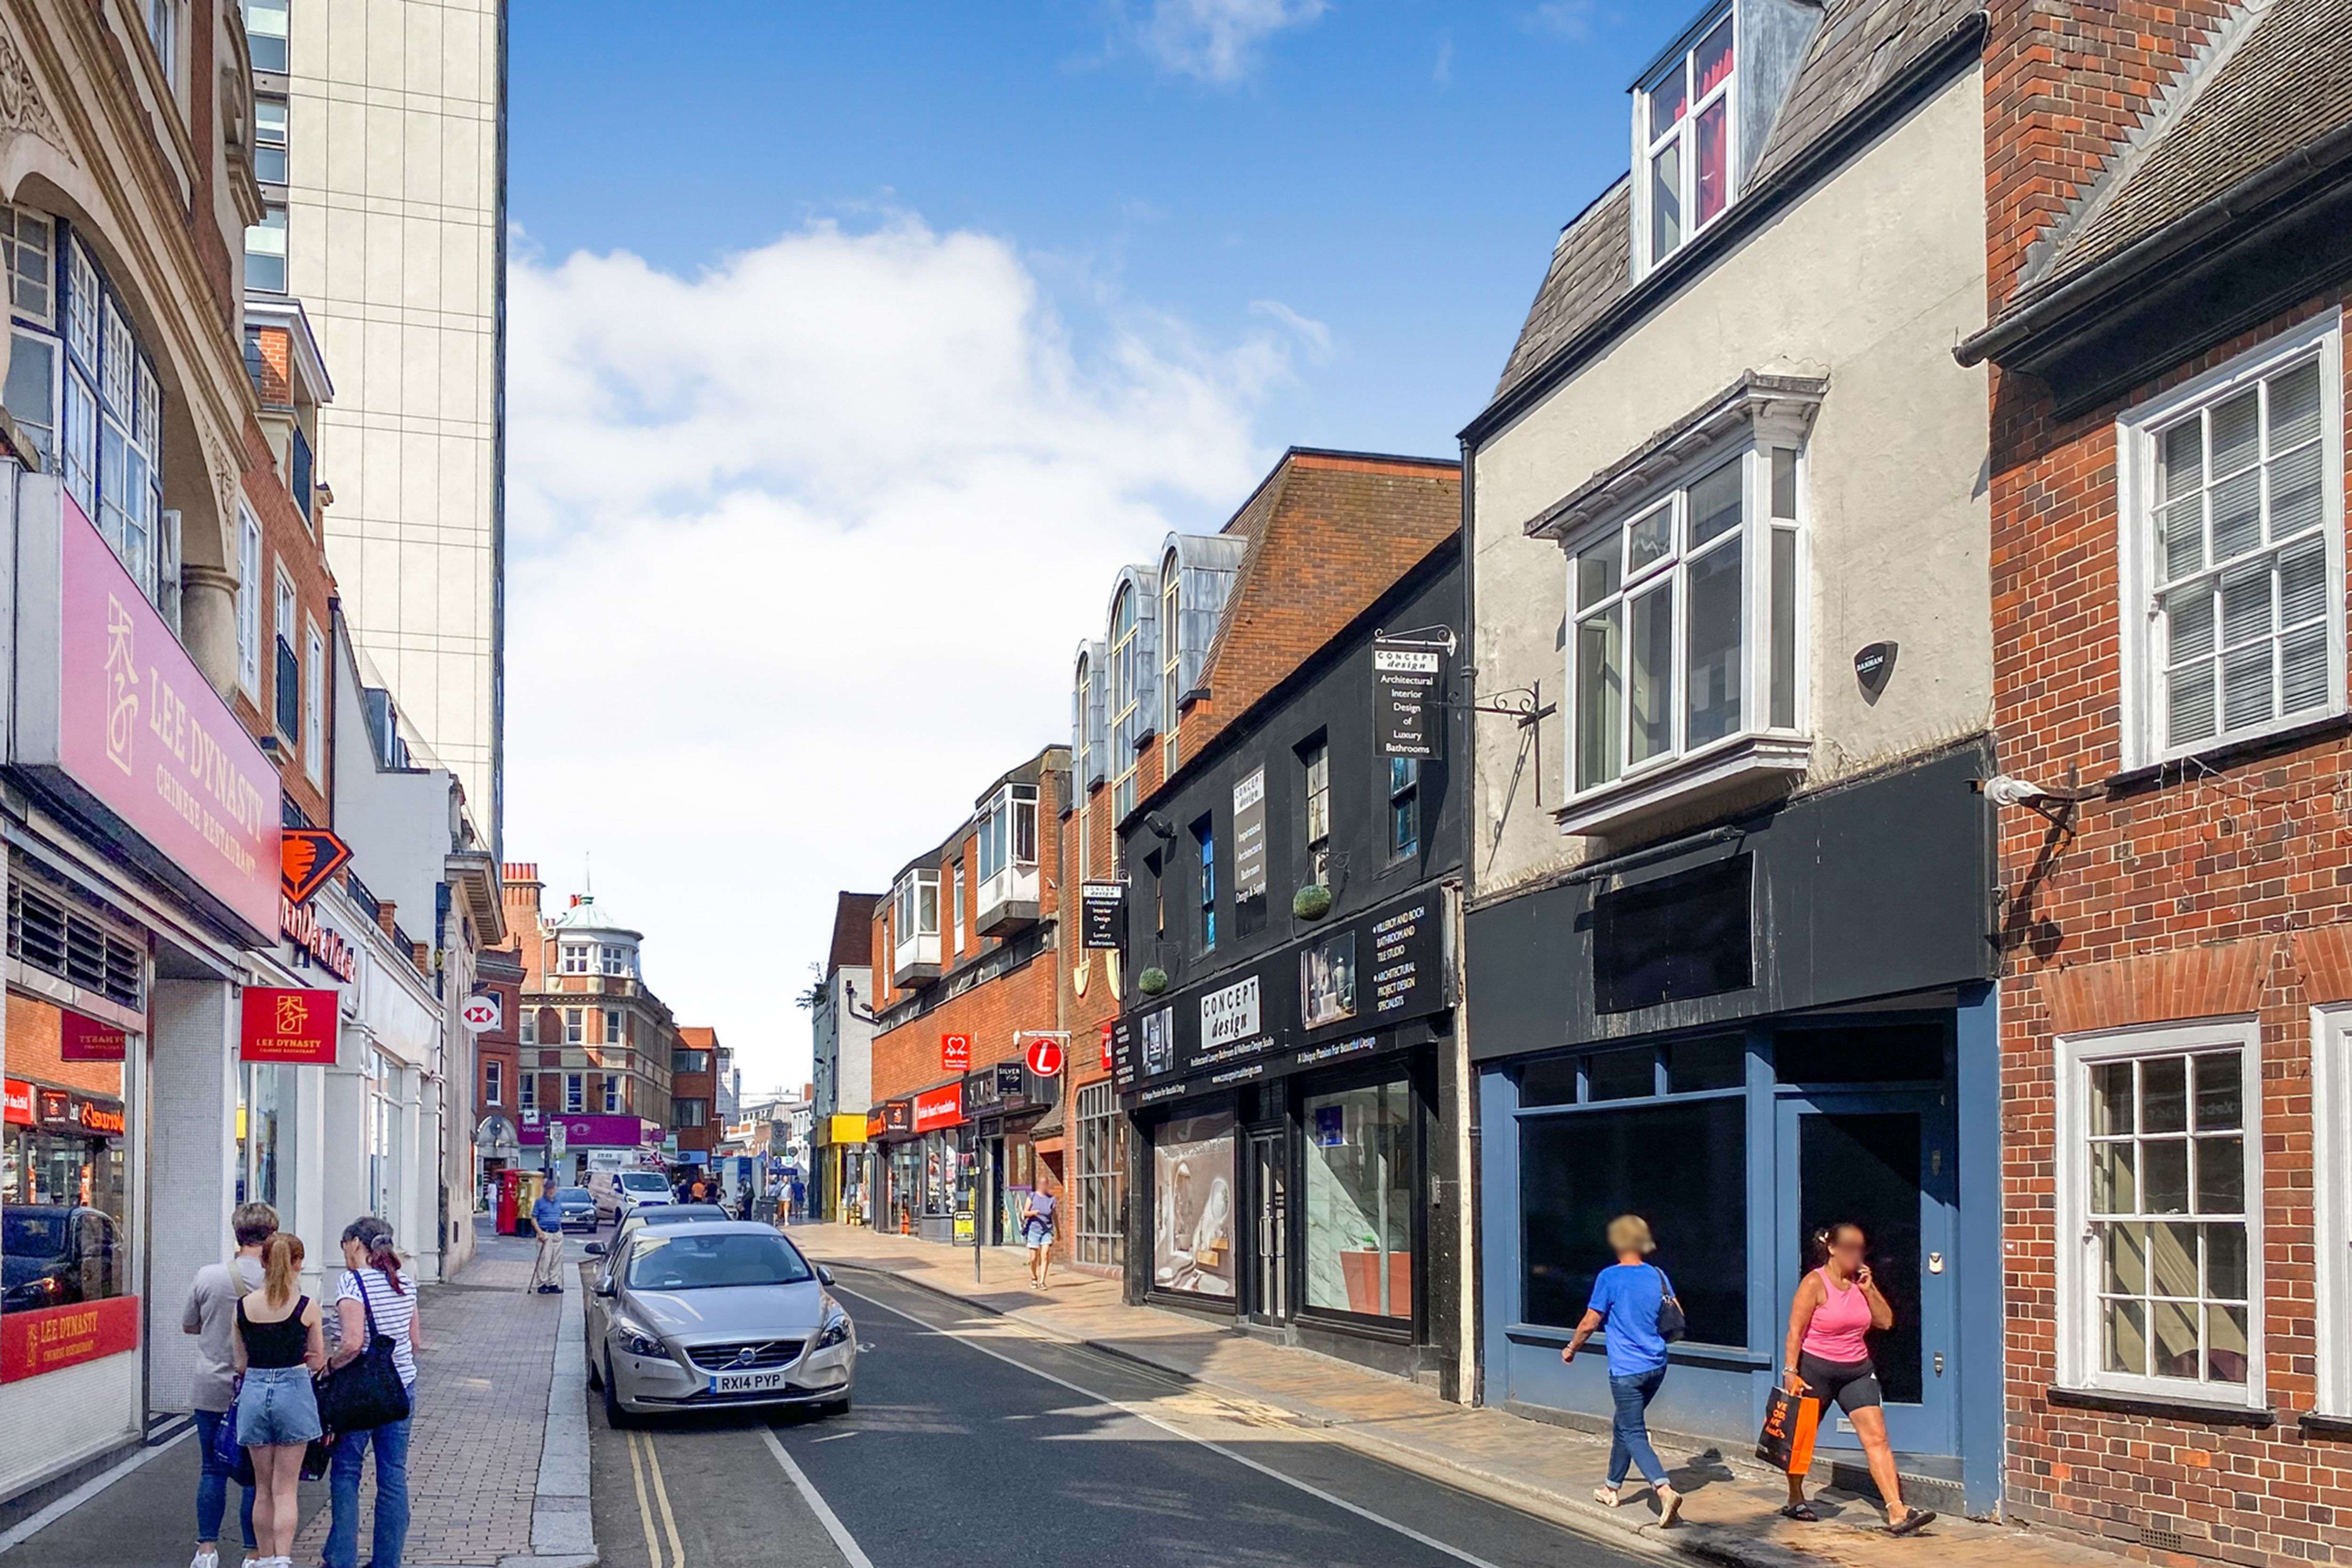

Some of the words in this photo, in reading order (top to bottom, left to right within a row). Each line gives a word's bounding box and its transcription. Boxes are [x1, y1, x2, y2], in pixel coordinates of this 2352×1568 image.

[1378, 652, 1434, 661] CONCEPT
[1387, 660, 1426, 670] design
[1380, 674, 1433, 685] Architectural
[1391, 689, 1422, 699] Interior
[1393, 702, 1421, 714] Design
[1403, 716, 1412, 725] of
[1393, 730, 1422, 741] Luxury
[150, 666, 186, 763] LEE
[190, 717, 263, 844] DYNASTY
[1386, 743, 1430, 754] Bathrooms
[1235, 773, 1263, 799] CONCEPT
[157, 763, 201, 831] CHINESE
[203, 809, 256, 882] RESTAURANT
[1397, 912, 1408, 926] AND
[1408, 906, 1425, 921] BOCH
[1376, 931, 1404, 948] BATHROOM
[1403, 925, 1415, 938] AND
[1377, 951, 1387, 963] TILE
[1387, 944, 1405, 960] STUDIO
[1377, 962, 1416, 982] ARCHITECTURAL
[1377, 982, 1397, 997] PROJECT
[1397, 977, 1415, 992] DESIGN
[1203, 981, 1255, 1018] CONCEPT
[1212, 1012, 1247, 1038] design
[277, 1039, 322, 1048] DYNASTY
[1297, 1053, 1302, 1065] A
[1359, 1036, 1376, 1049] Design
[41, 1319, 57, 1343] LEE
[59, 1311, 98, 1339] DYNASTY
[722, 1377, 751, 1390] RX14
[755, 1375, 780, 1388] PYP
